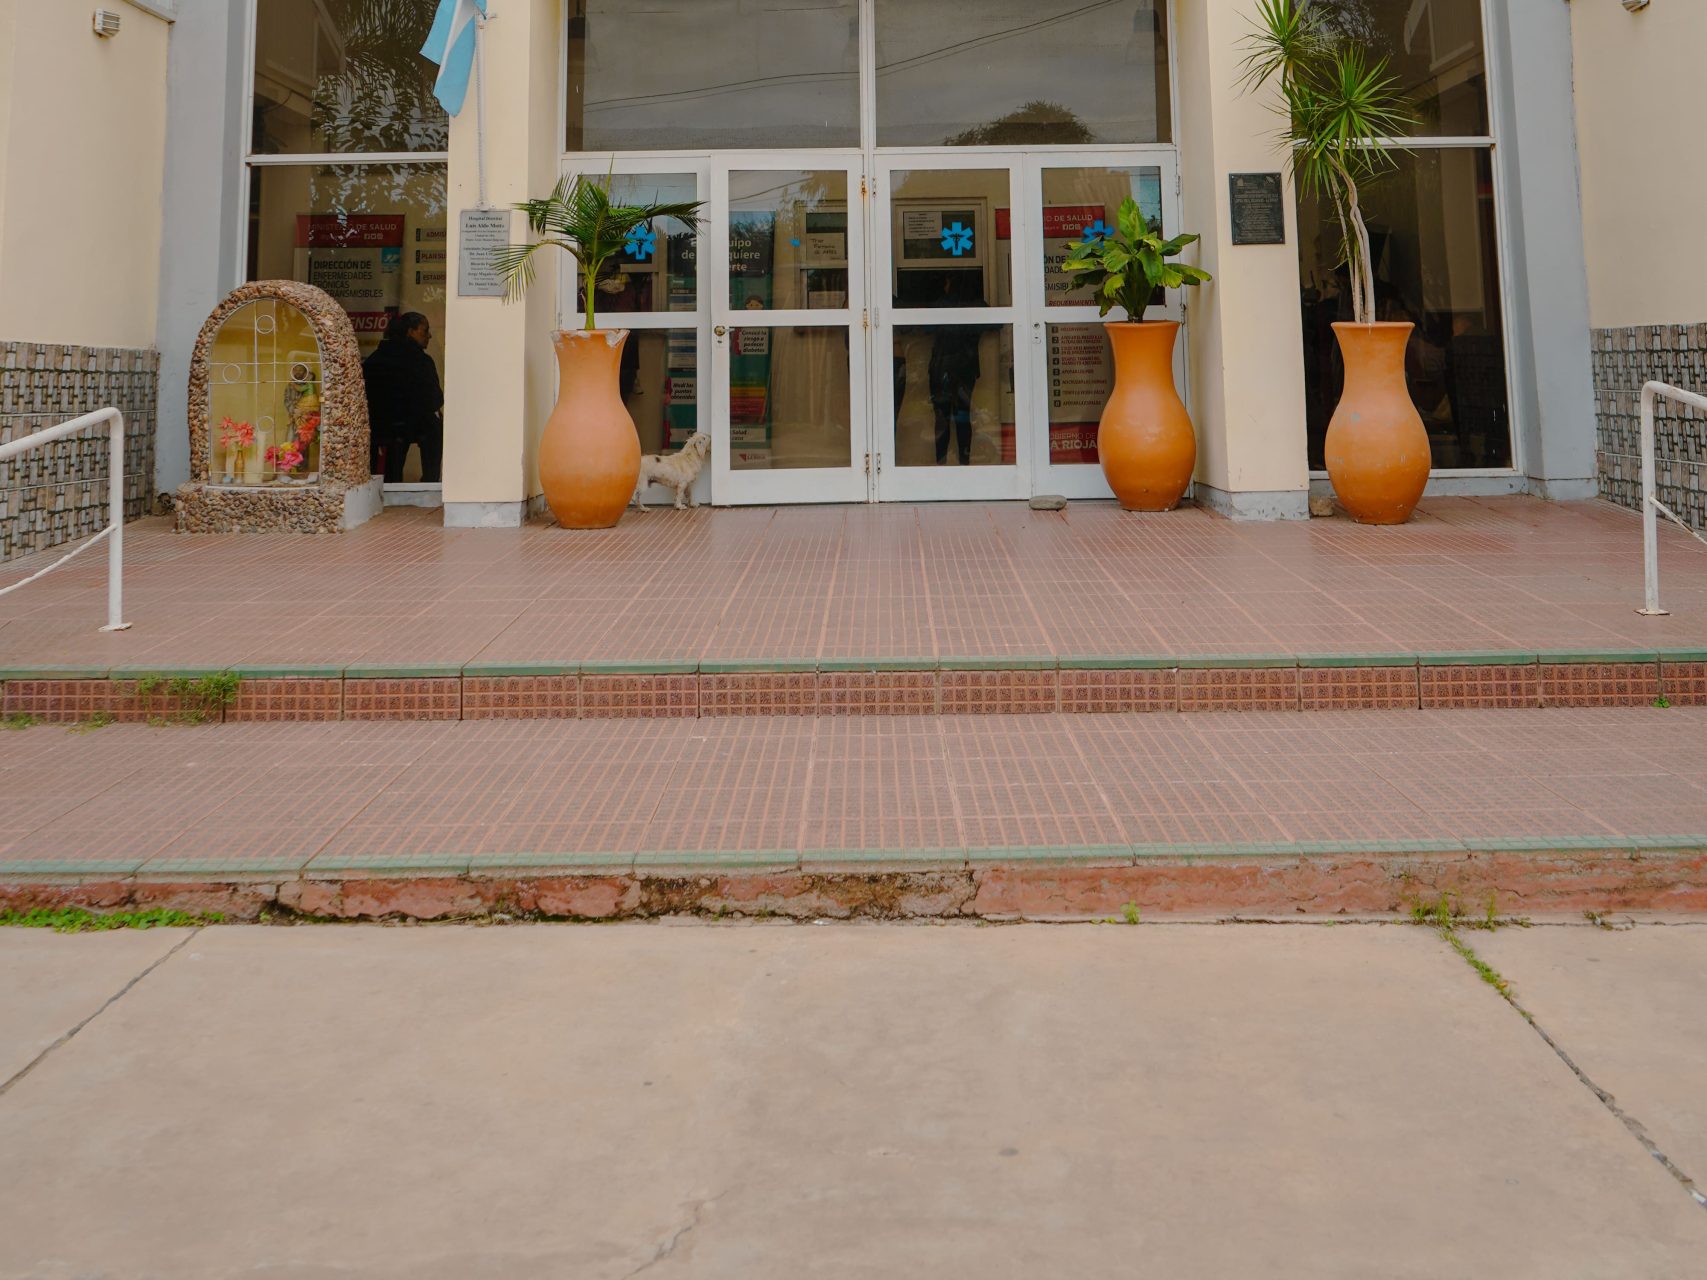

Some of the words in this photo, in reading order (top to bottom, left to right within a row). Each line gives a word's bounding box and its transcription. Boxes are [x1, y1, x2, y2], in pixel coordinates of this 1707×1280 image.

[1066, 214, 1093, 222] SALUD
[369, 223, 397, 231] SALUD
[313, 259, 359, 270] DIRECCIÓN
[360, 260, 372, 270] DE
[313, 271, 373, 280] ENFERMEDADES
[1062, 439, 1098, 449] RIOJA
